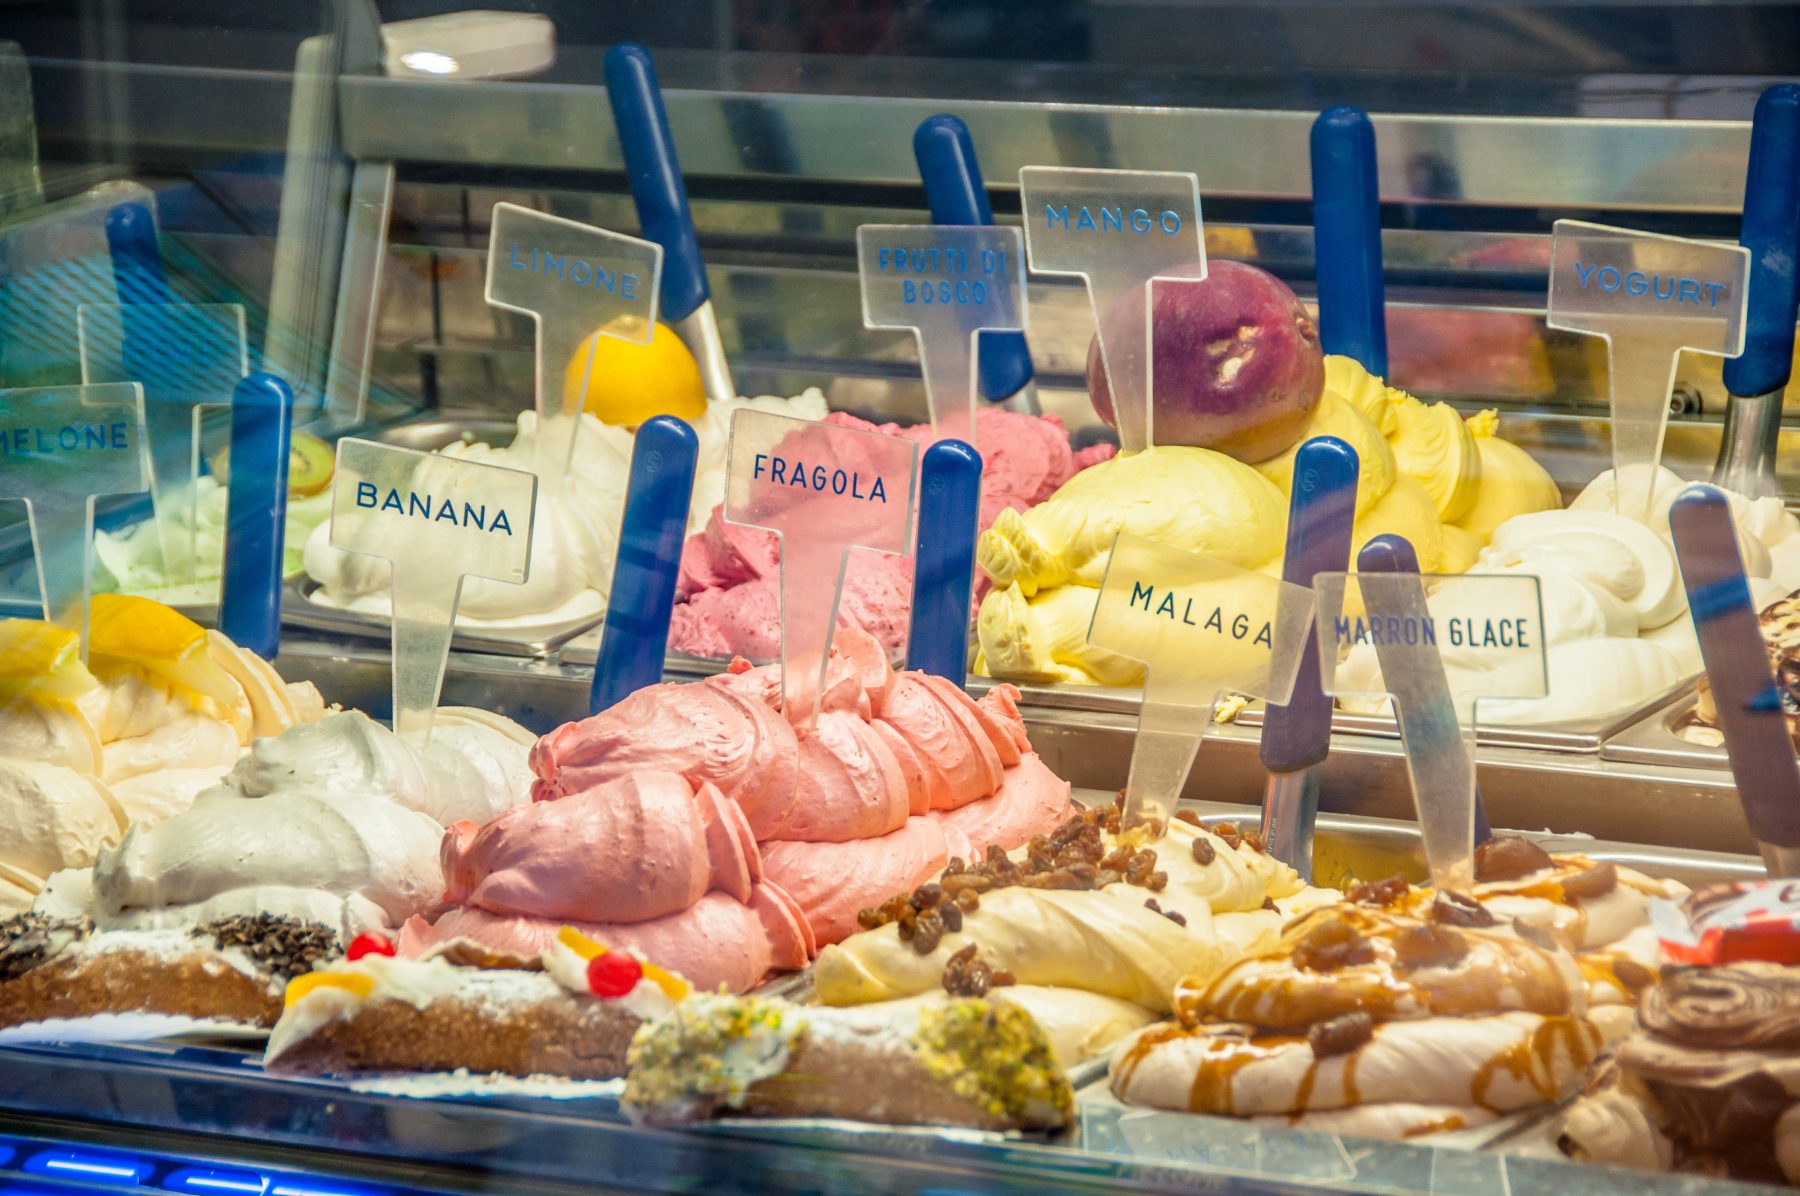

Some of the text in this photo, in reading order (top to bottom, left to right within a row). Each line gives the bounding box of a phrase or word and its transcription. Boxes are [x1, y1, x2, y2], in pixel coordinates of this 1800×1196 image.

[1045, 203, 1182, 235] MANGO
[511, 242, 640, 300] LIMONE
[879, 248, 1006, 274] FRUTTI DI
[1574, 260, 1726, 308] YOGURT
[903, 279, 987, 304] BOSCO
[754, 453, 887, 504] FRAGOLA
[356, 481, 513, 536] BANANA
[1130, 580, 1272, 649] MALAGA
[1334, 615, 1437, 646] MARRON
